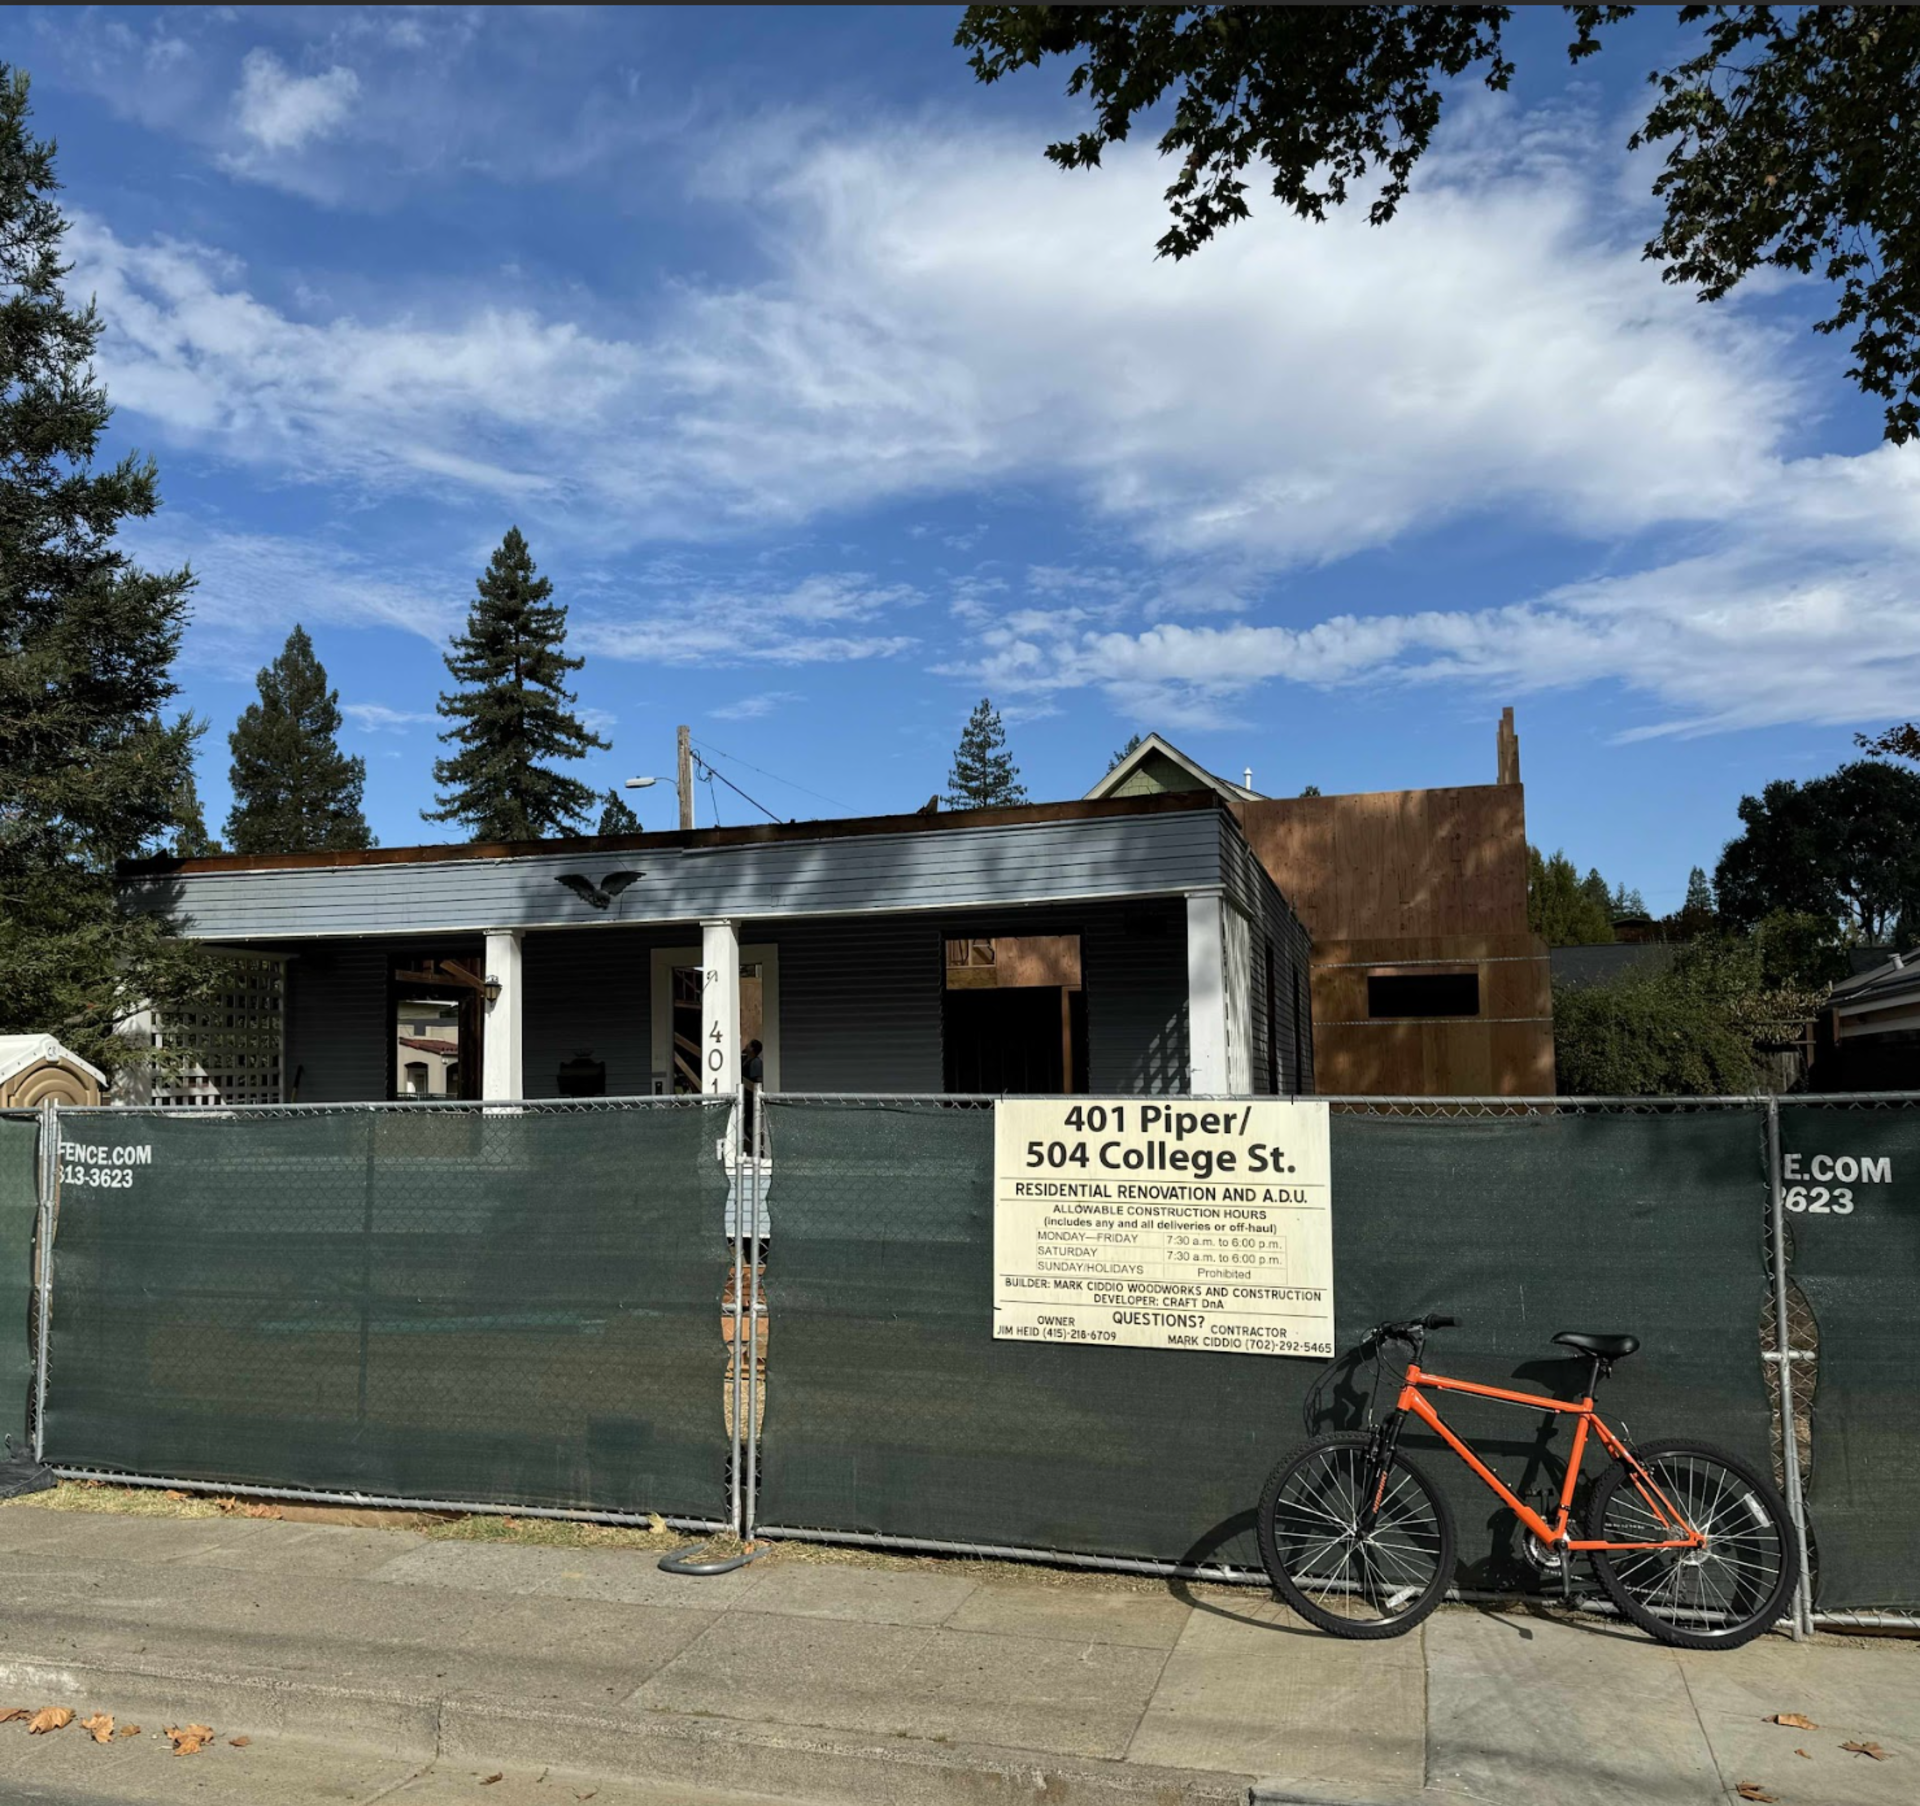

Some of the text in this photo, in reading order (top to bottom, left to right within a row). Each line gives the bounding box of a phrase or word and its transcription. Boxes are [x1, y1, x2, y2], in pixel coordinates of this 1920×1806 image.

[1065, 1104, 1252, 1141] 401 Piper/
[1026, 1140, 1296, 1179] 504 College St.
[1784, 1153, 1892, 1183] E.COM
[1016, 1183, 1308, 1203] RESIDENTIAL RENOVATION AND A.D.U.
[1781, 1186, 1854, 1214] 623
[1053, 1204, 1267, 1219] ALLOWABLE CONSTRUCTION HOURS
[1044, 1217, 1277, 1234] (includes any and all deliveries or off-haul)
[1166, 1235, 1190, 1247] 7:30
[1192, 1237, 1216, 1247] a.m.
[1218, 1237, 1229, 1248] to
[1231, 1238, 1255, 1248] 6:00
[1258, 1240, 1282, 1250] p.m.
[1038, 1247, 1282, 1266] SATURDAY 7:30 a.m. to 6:00 p.m.
[1038, 1261, 1251, 1279] SUNDAY/HOLIDAYS Prohibited
[1006, 1278, 1321, 1301] BUILDER: MARK CIDDIO WOODWORKS AND CONSTRUCTION
[1094, 1294, 1224, 1309] DEVELOPER: CRAFT DnA
[1037, 1316, 1075, 1327] OWNER
[1112, 1312, 1205, 1328] QUESTIONS?
[997, 1326, 1014, 1335] JIM
[1016, 1326, 1040, 1336] HEID
[1211, 1325, 1287, 1338] CONTRACTOR
[1167, 1335, 1201, 1346] MARK
[1204, 1337, 1242, 1349] CIDDIO
